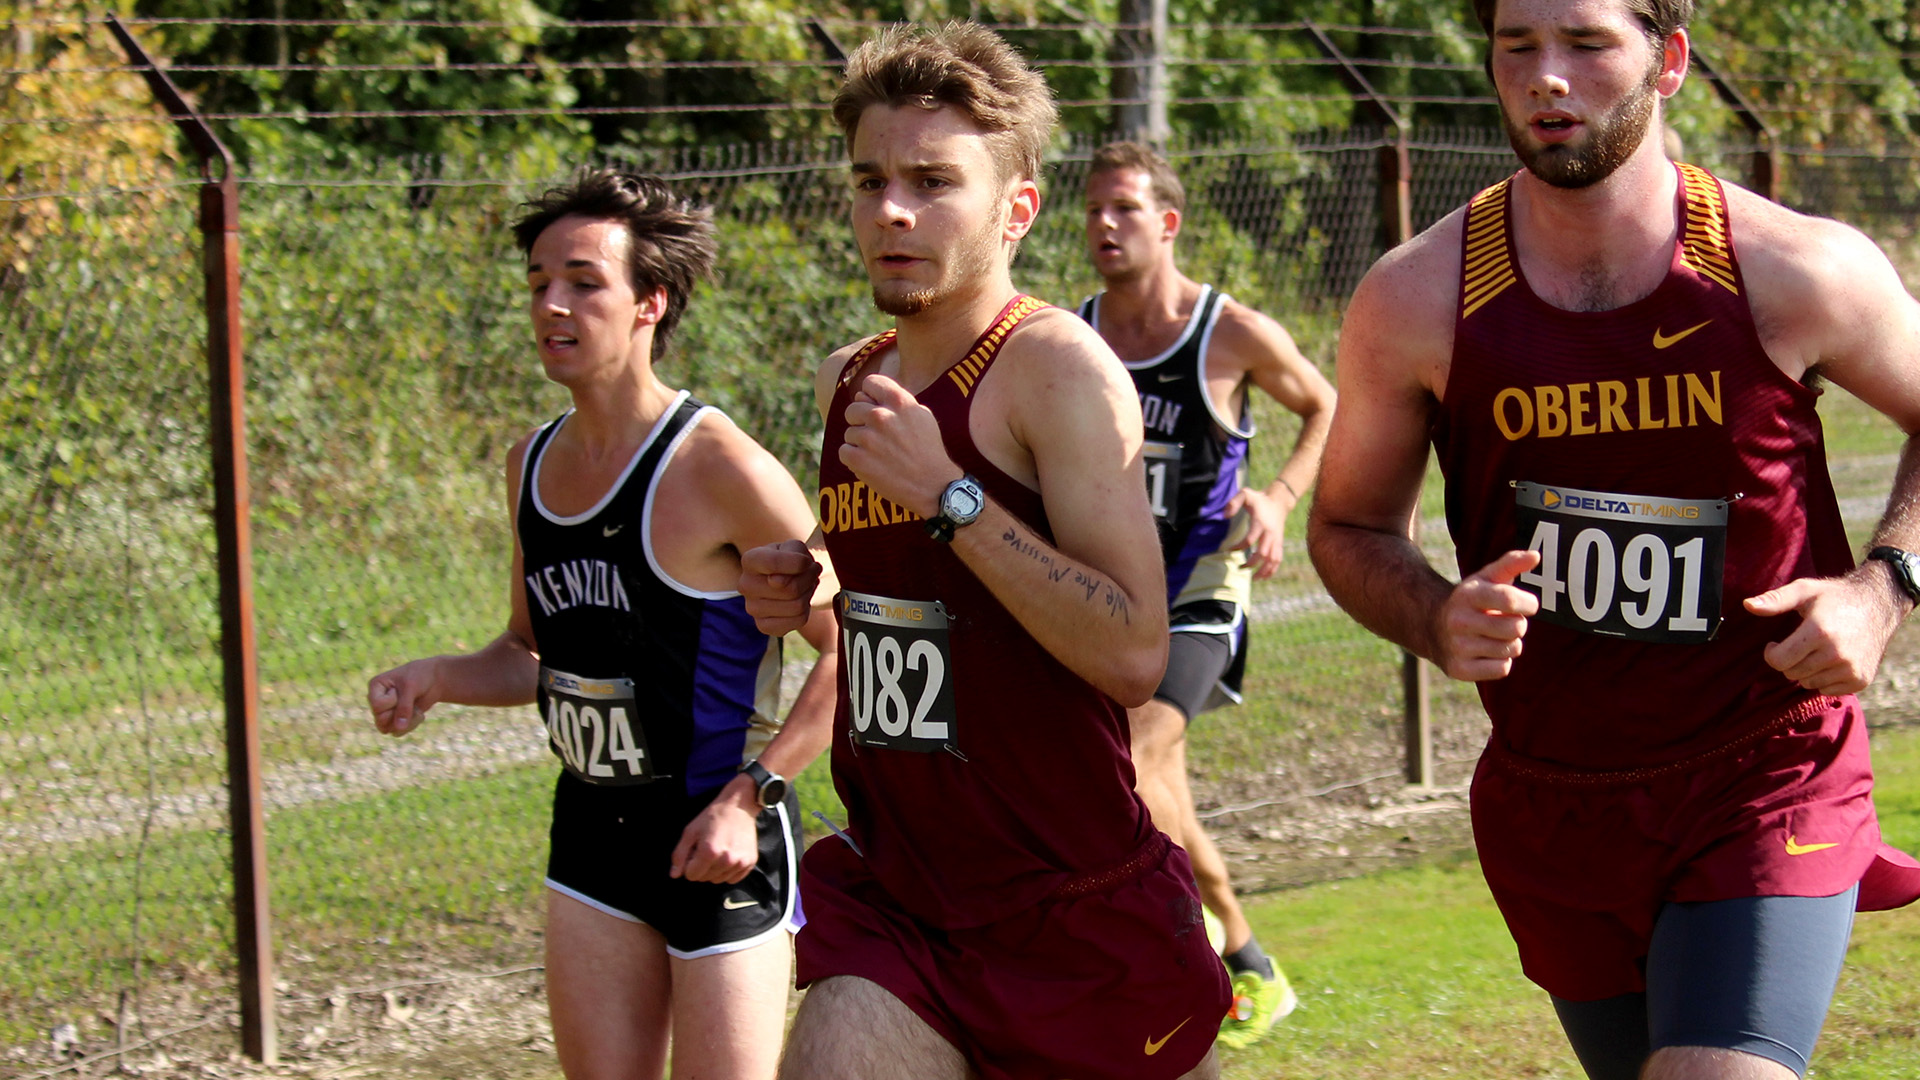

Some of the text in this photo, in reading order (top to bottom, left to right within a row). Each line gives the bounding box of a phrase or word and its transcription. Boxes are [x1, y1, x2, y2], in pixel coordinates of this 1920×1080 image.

[1493, 370, 1723, 441] OBERLIN
[1564, 495, 1699, 520] DELTATIMING
[851, 599, 924, 622] DELTATIMING
[1002, 526, 1129, 626] We Are Massive
[1520, 521, 1708, 632] 4091
